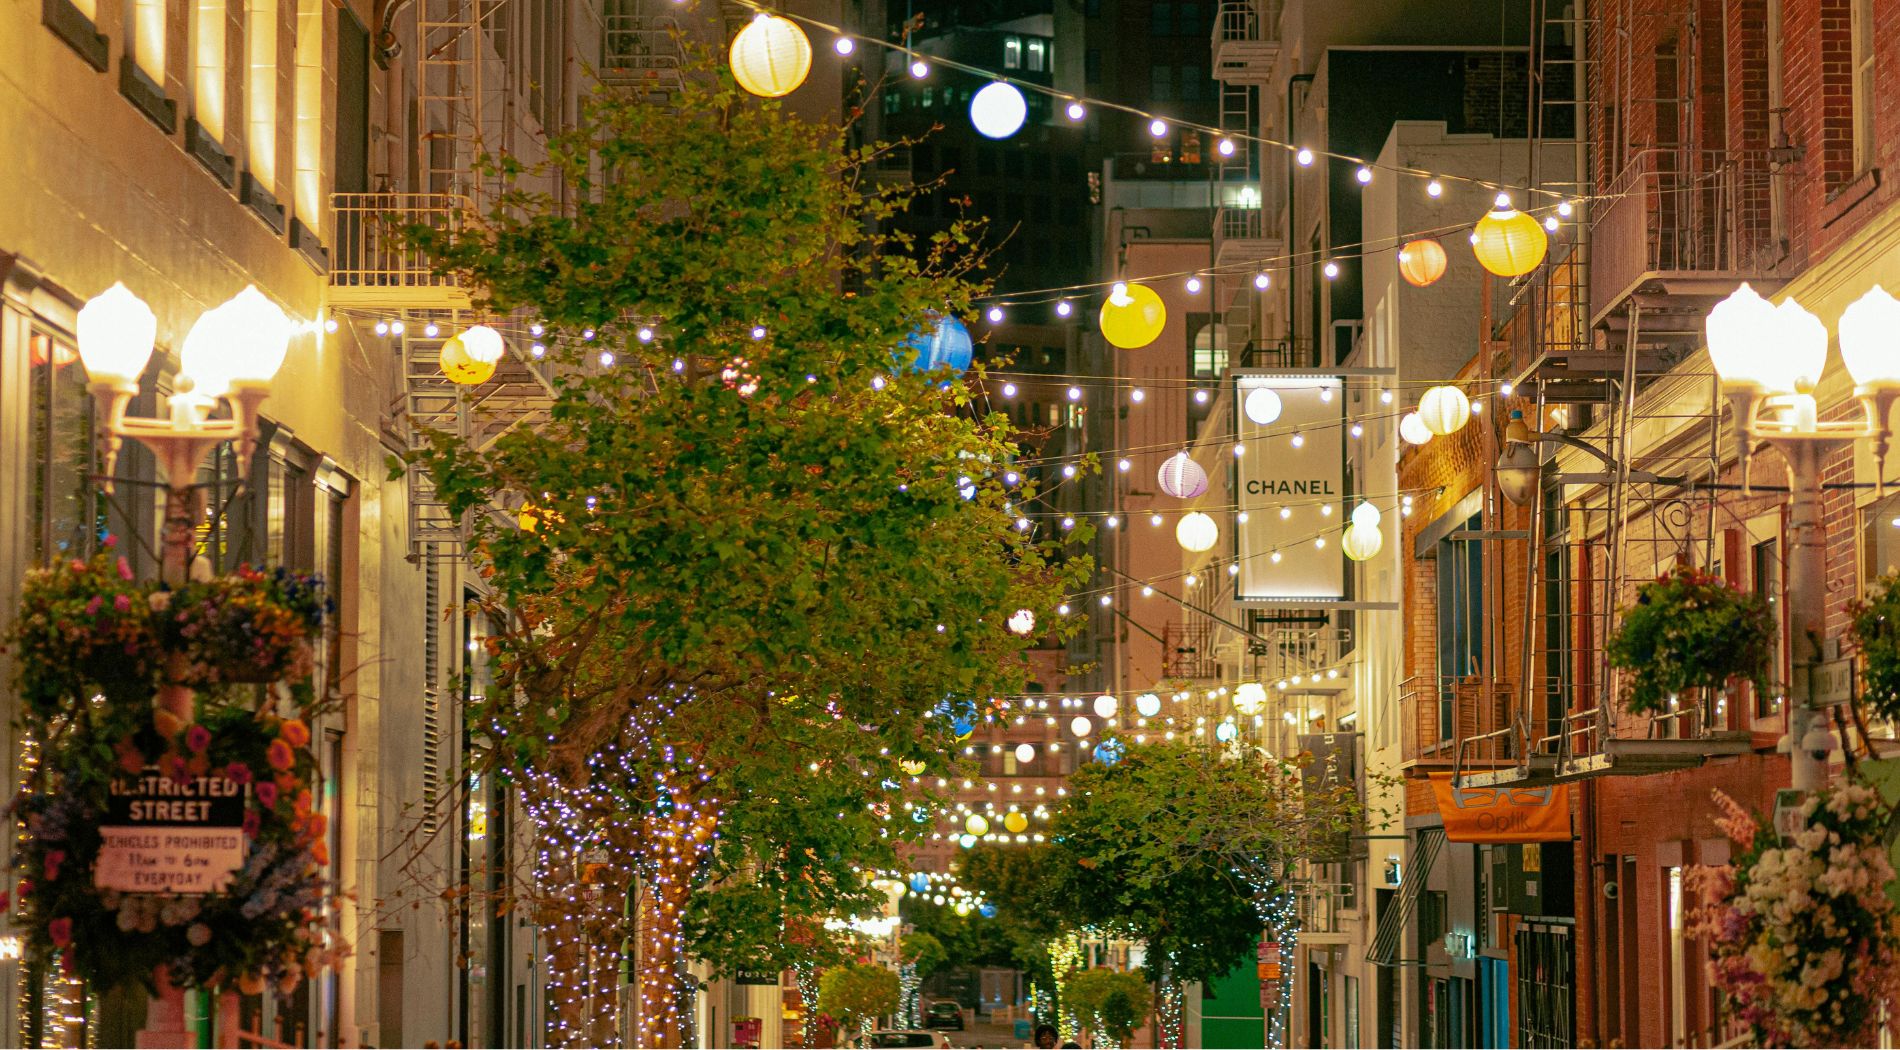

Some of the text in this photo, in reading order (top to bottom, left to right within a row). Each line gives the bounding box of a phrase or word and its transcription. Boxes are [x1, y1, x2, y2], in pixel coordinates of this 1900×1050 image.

[1246, 479, 1335, 495] CHANEL
[129, 799, 212, 821] STREET
[1477, 811, 1531, 833] Optik
[165, 835, 238, 850] PROHIBITED
[134, 872, 203, 886] EVERYDAY
